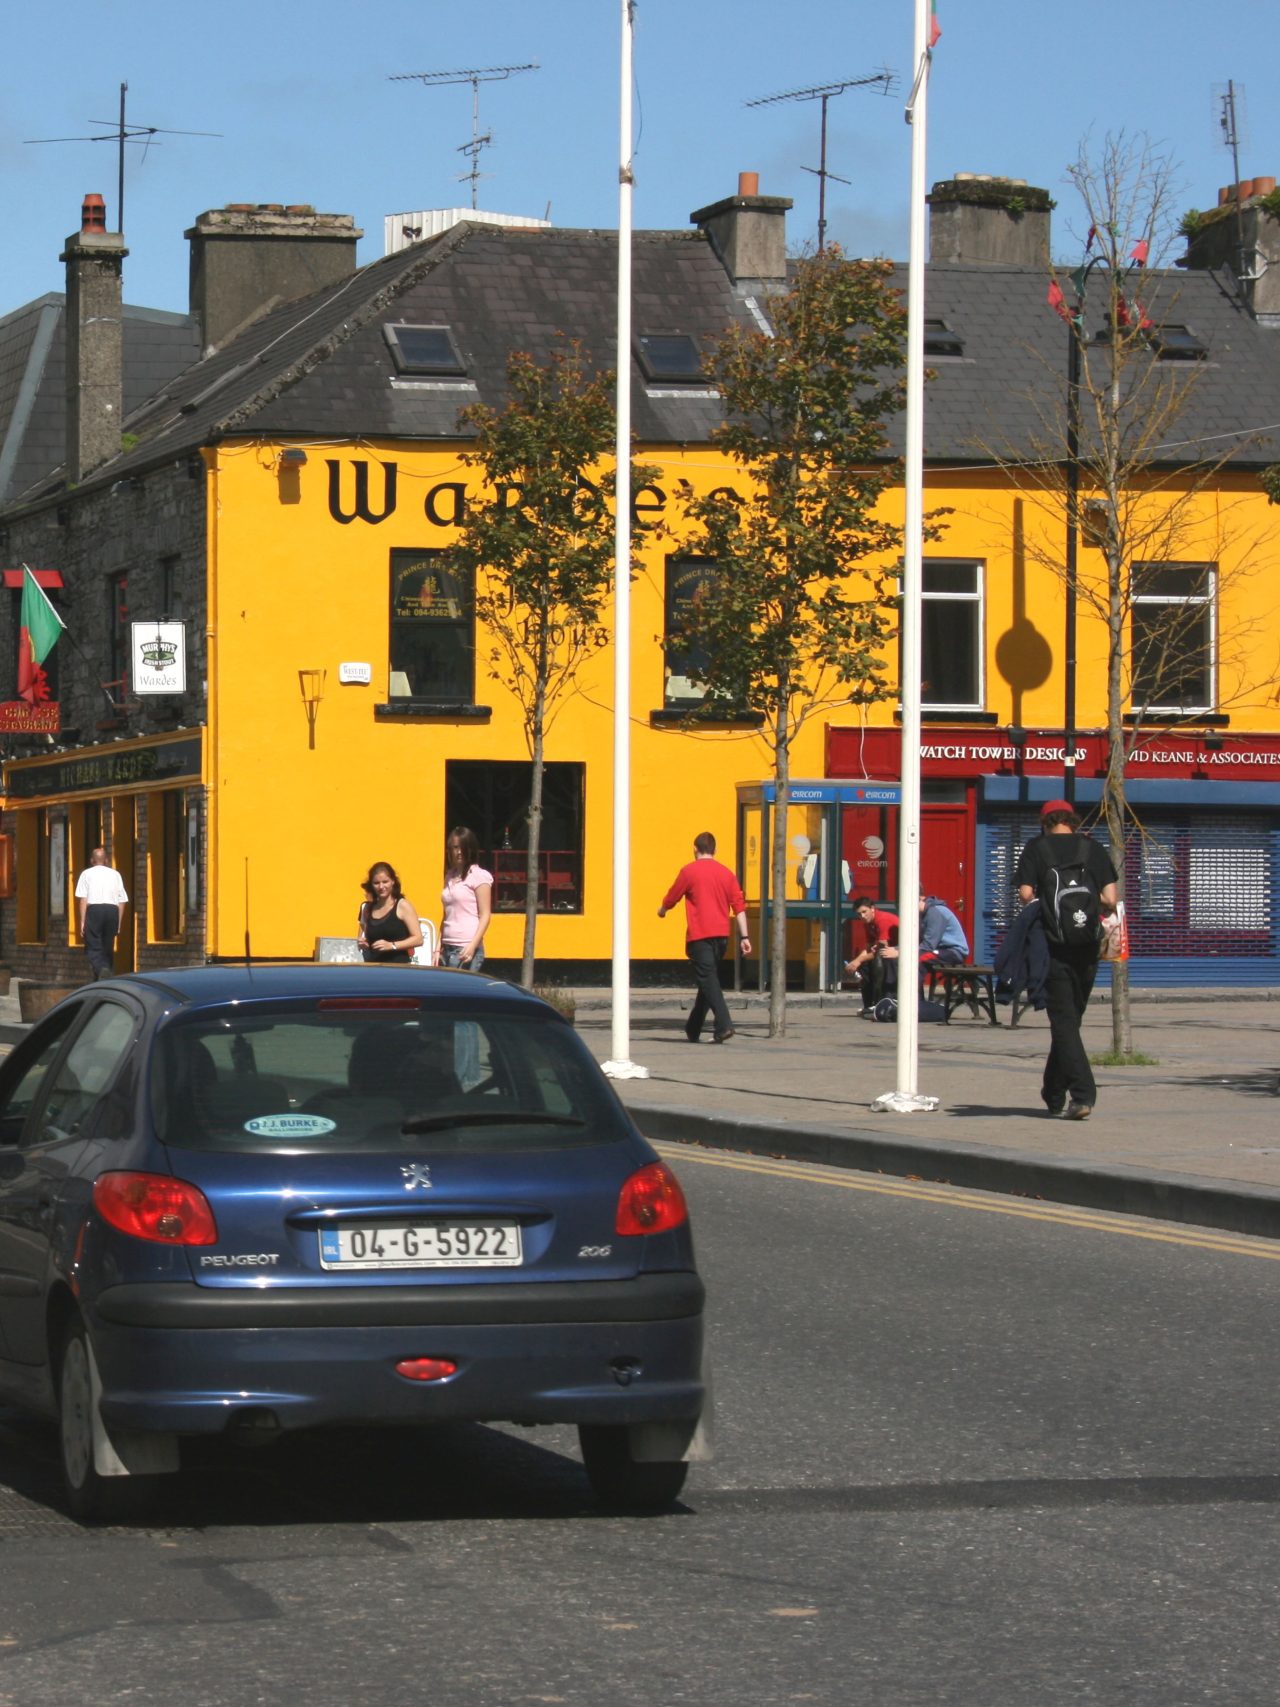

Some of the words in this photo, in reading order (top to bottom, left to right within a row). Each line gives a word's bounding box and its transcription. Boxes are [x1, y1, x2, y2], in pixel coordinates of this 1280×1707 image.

[969, 747, 1021, 760] TOWER
[1152, 751, 1194, 763] KEANE
[1197, 753, 1207, 763] &
[791, 790, 822, 798] eircom
[865, 791, 896, 799] eircom
[857, 859, 888, 868] eircom
[280, 1120, 318, 1128] BURKE
[350, 1227, 508, 1258] 04-G-5922
[578, 1245, 612, 1257] 206
[200, 1253, 280, 1267] PEUGEOT
